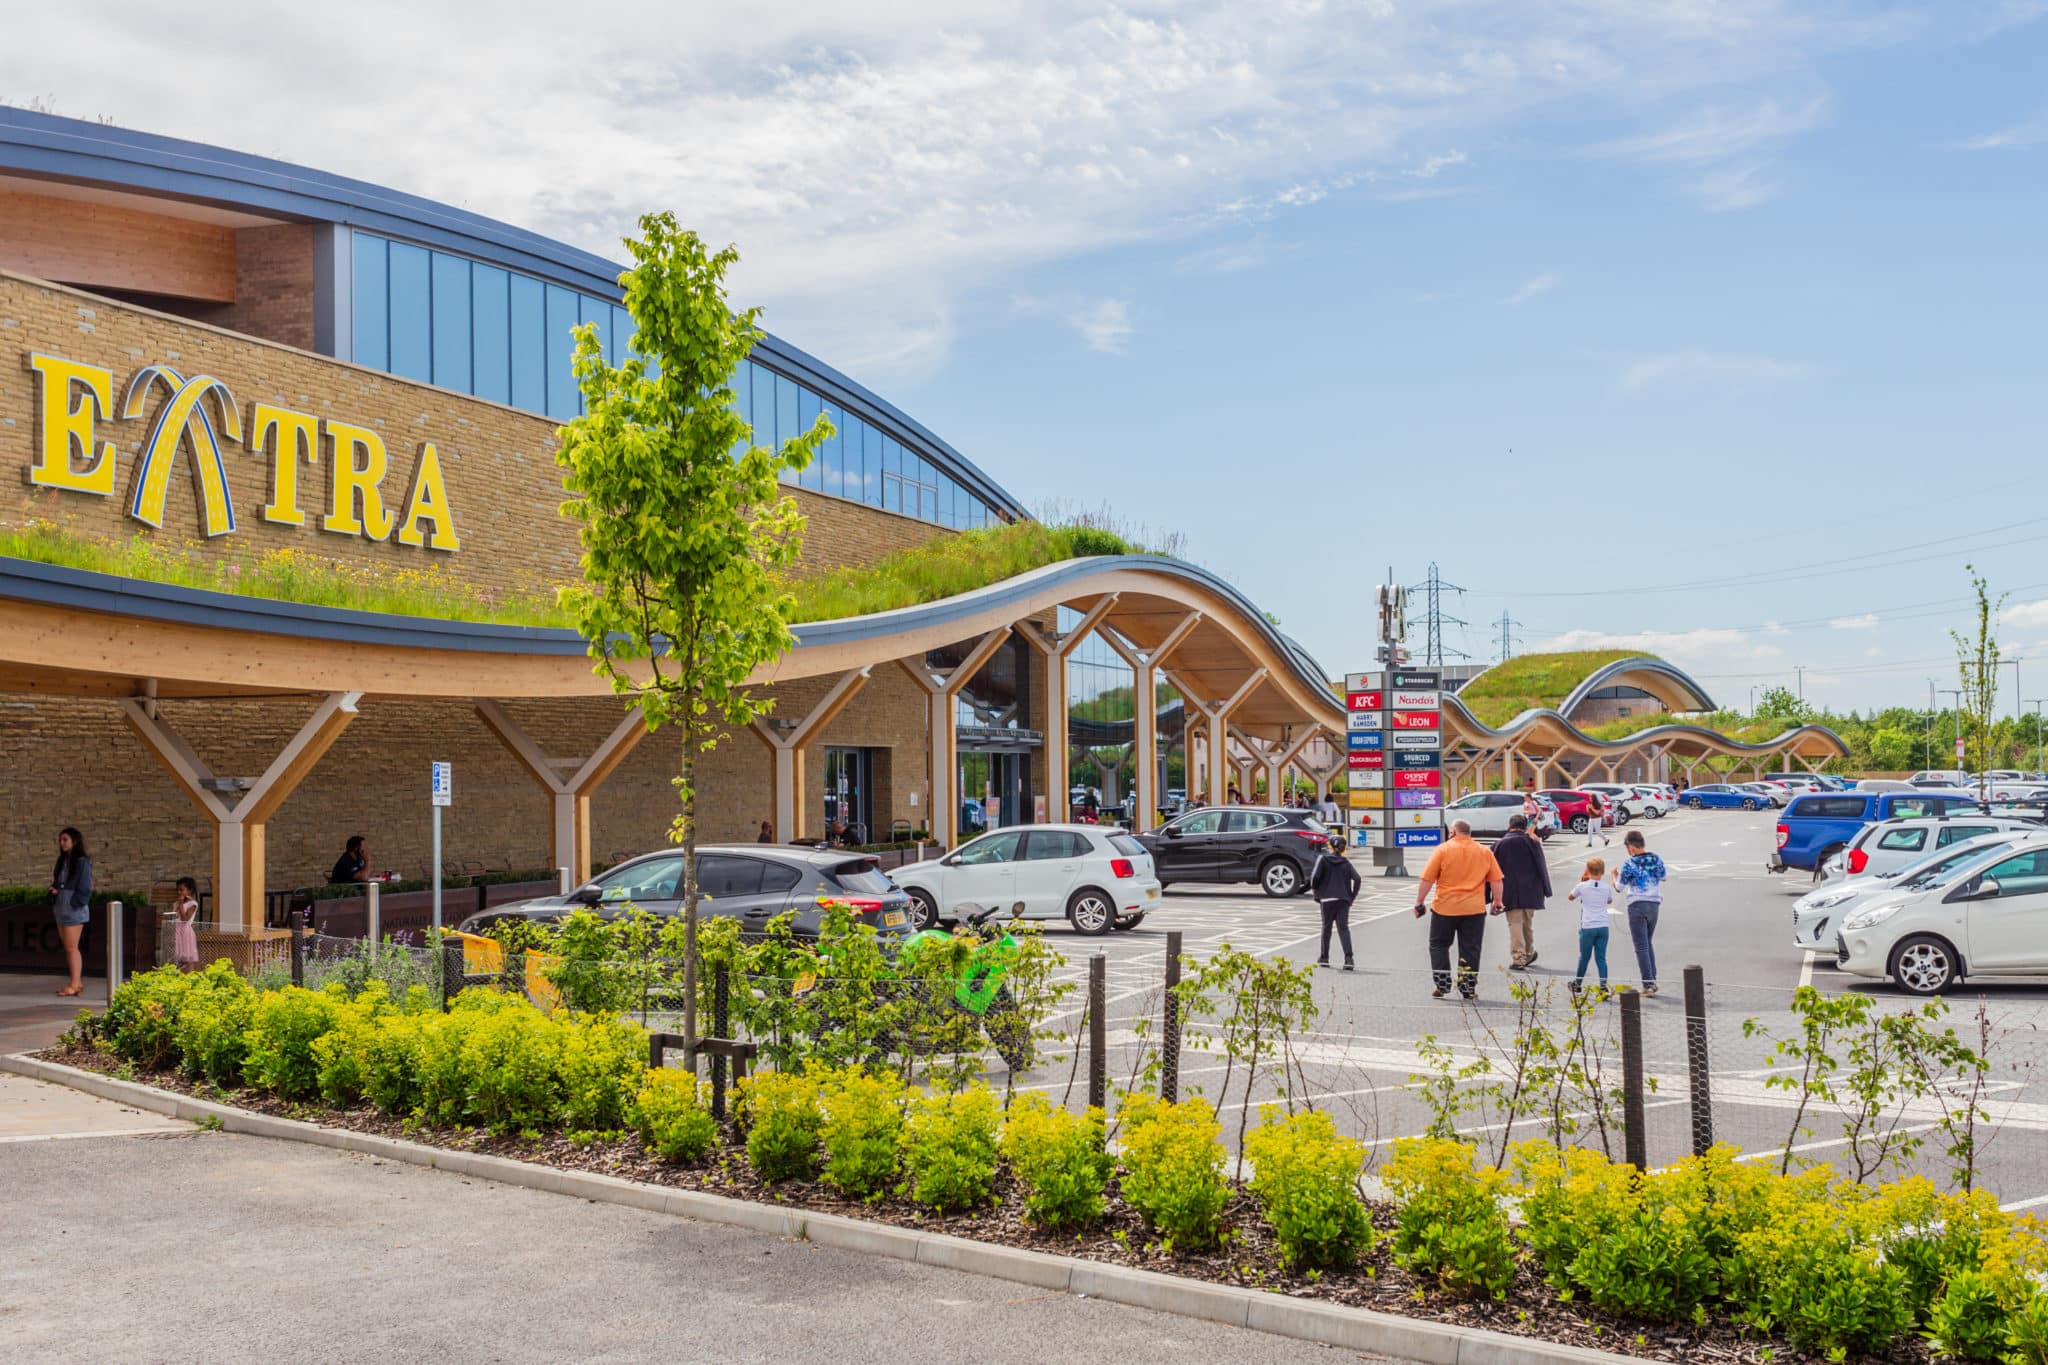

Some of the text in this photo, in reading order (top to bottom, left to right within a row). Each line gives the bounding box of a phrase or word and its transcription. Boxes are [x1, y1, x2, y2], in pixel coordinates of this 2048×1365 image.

[30, 351, 461, 552] EXTRA
[1355, 696, 1375, 708] KFC
[1398, 695, 1434, 705] Nando's
[1409, 718, 1430, 727] LEON
